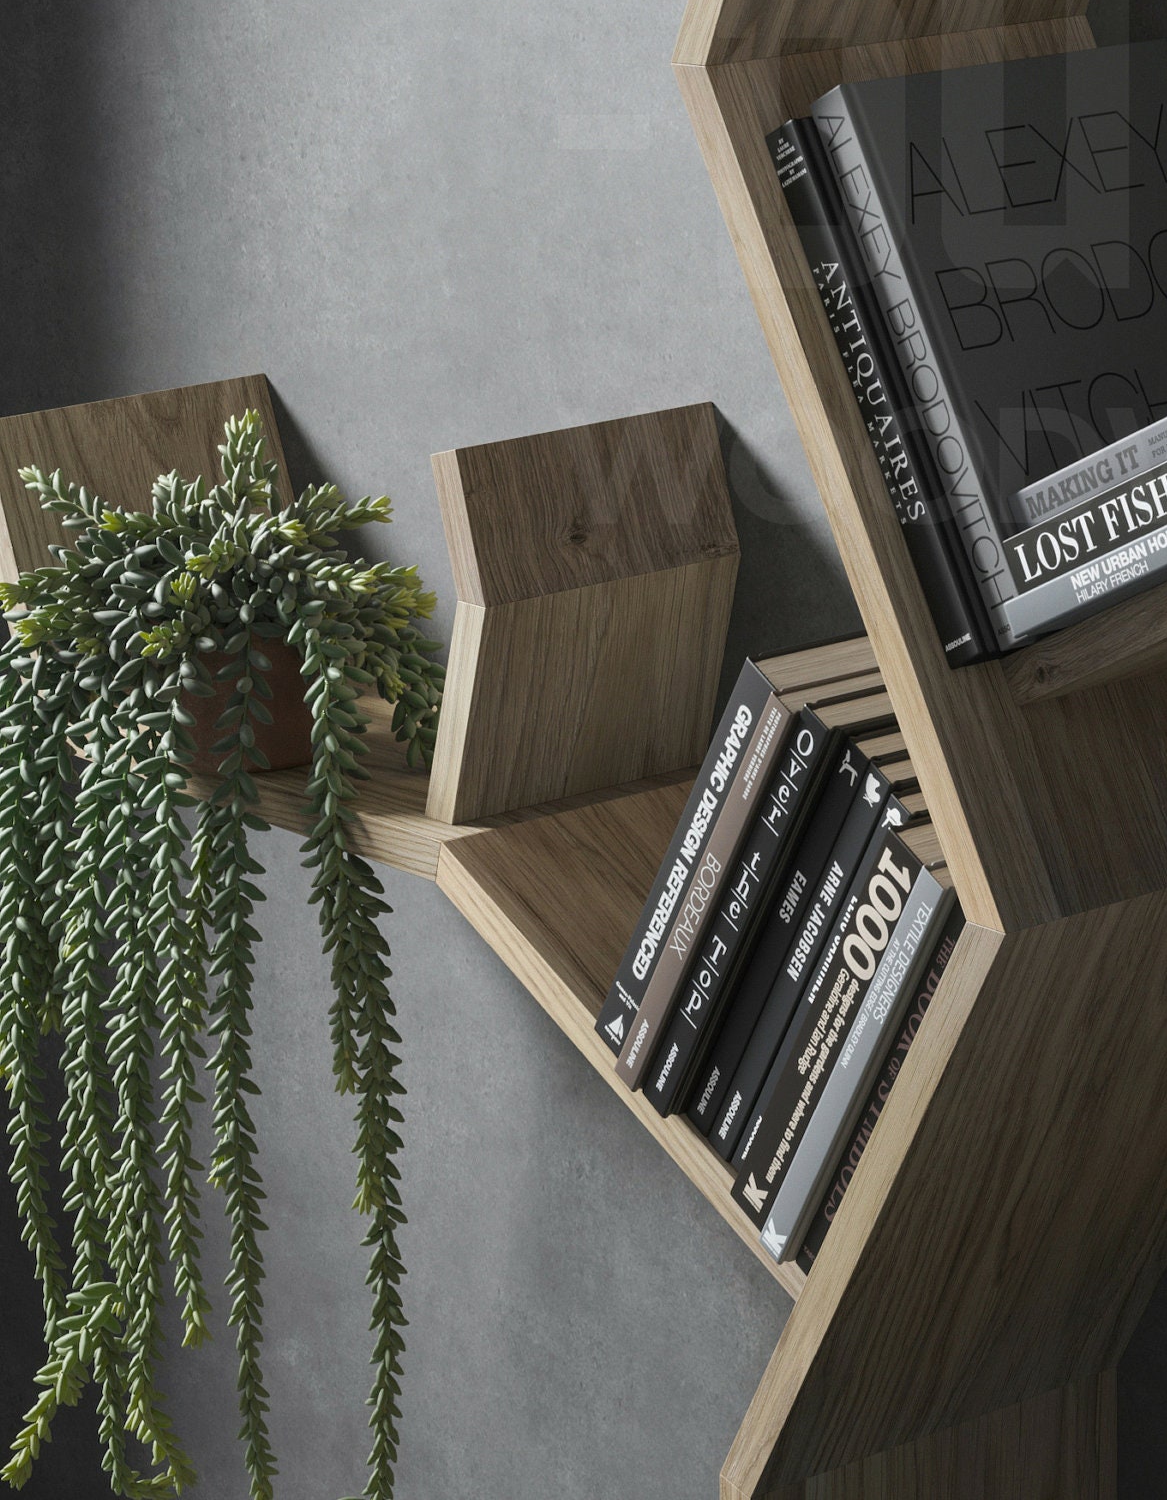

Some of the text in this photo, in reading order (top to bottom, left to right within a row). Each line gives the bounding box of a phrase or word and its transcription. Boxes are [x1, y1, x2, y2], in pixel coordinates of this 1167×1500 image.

[909, 103, 1167, 226] ALEXEY
[817, 115, 1014, 610] ALEXEY BRODOVITCH
[867, 420, 908, 526] MARKETS
[1150, 445, 1166, 458] FOR
[1025, 444, 1140, 520] MAKING IT
[1013, 509, 1098, 583] LOST
[1070, 567, 1101, 591] NEW
[1101, 544, 1148, 575] URBAN
[1075, 561, 1150, 604] HILARY FRENCH
[632, 704, 752, 982] GRAPHIC DESIGN REFERENCED
[669, 851, 721, 961] BORDEAUX
[779, 869, 808, 925] EAMES
[826, 860, 845, 907] ARNE
[842, 846, 912, 982] 1000
[786, 902, 827, 984] JACOBSEN
[872, 901, 933, 1025] TEXTILE DESIGNERS
[885, 948, 896, 964] THE
[892, 937, 900, 951] AT
[838, 978, 860, 1018] designs
[872, 962, 890, 994] CUTTING
[797, 967, 850, 1075] Geraldine and Ian Rudge
[833, 1013, 845, 1032] for
[864, 991, 878, 1013] EDGE
[625, 1018, 650, 1069] ASSOULINE
[825, 1028, 838, 1048] the
[850, 1013, 868, 1047] BRADLEY
[655, 1042, 680, 1093] ASSOULINE
[809, 1041, 830, 1085] gardens
[840, 1043, 855, 1069] QUINN
[697, 1065, 722, 1116] ASSOULINE
[801, 1080, 814, 1105] and
[718, 1090, 743, 1140] ASSOULINE
[788, 1099, 806, 1131] where
[765, 1156, 782, 1184] them
[775, 1137, 790, 1163] find
